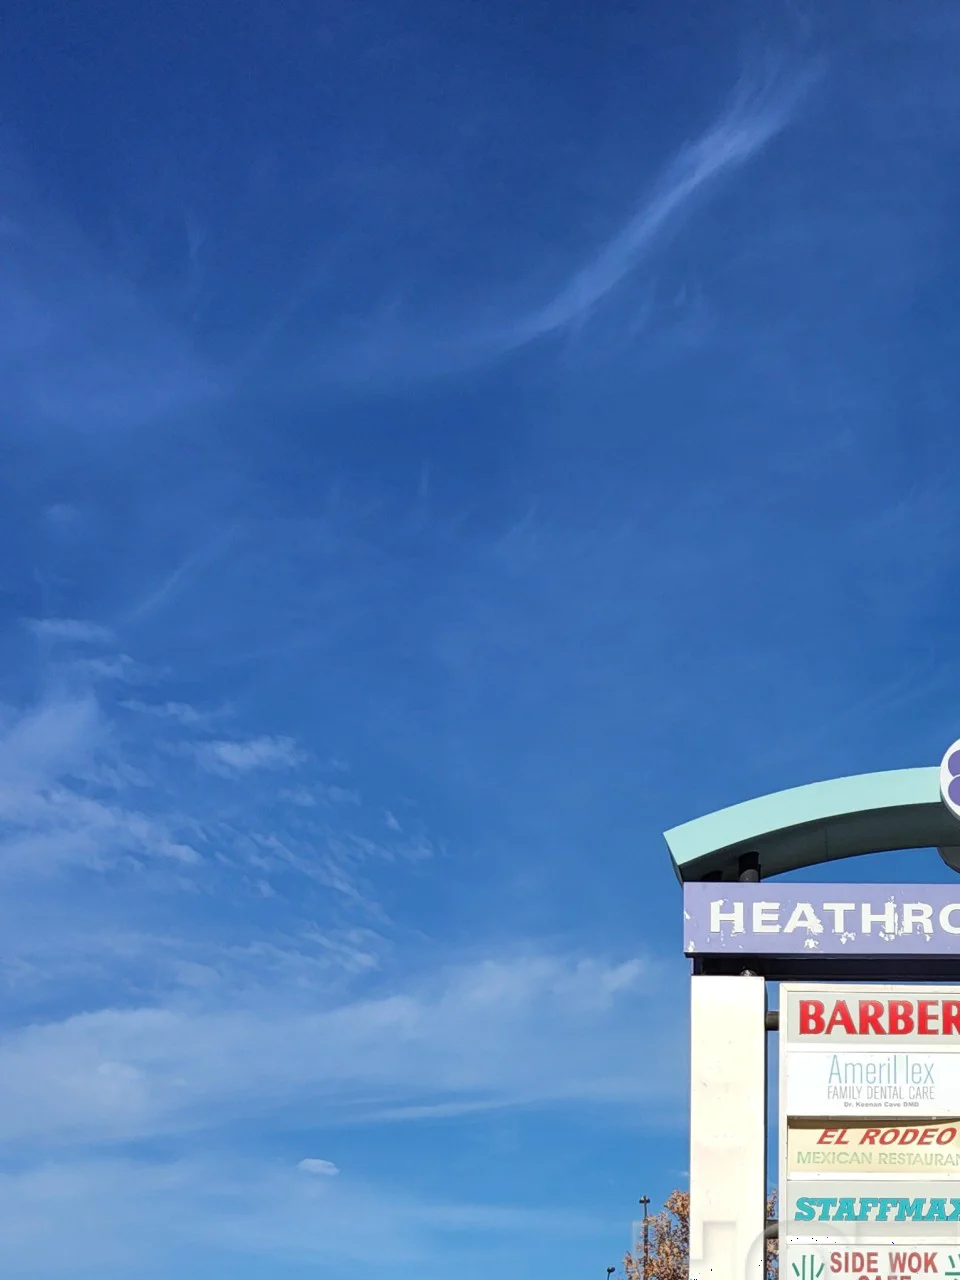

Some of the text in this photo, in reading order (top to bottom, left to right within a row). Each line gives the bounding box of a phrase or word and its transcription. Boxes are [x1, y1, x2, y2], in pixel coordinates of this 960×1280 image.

[827, 1085, 935, 1100] FAMILY DENTAL CARE
[816, 1126, 958, 1146] EL RODEO
[796, 1151, 873, 1165] MEXICAN
[830, 1251, 938, 1274] SIDE WOK
